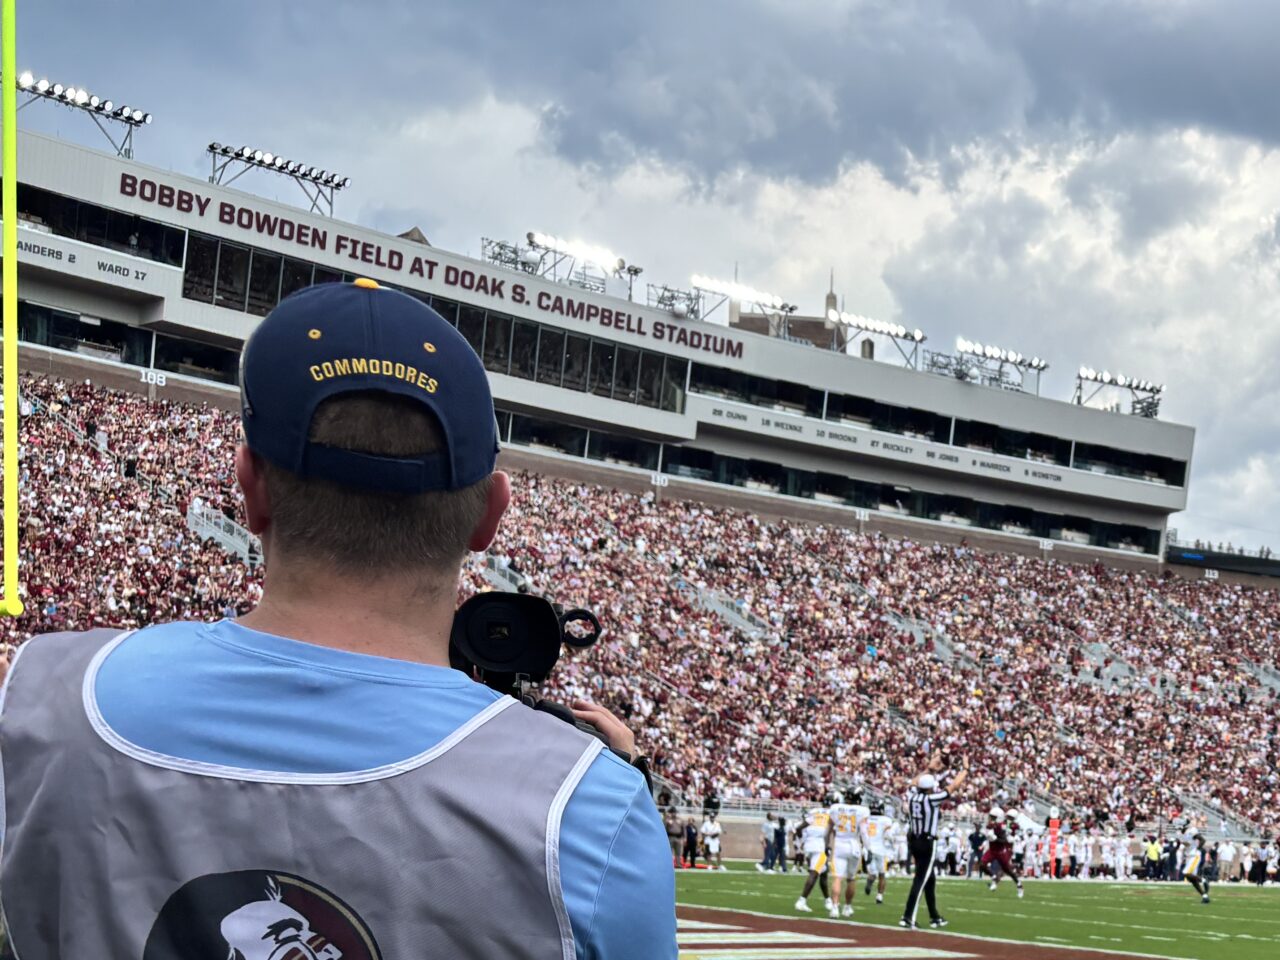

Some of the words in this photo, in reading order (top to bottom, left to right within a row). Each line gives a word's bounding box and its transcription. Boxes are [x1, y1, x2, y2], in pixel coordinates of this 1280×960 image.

[17, 240, 63, 261] ANDERS
[68, 253, 76, 264] 2
[97, 260, 130, 277] WARD
[134, 270, 147, 281] 17
[120, 172, 212, 217] BOBBY
[218, 201, 328, 250] BOWDEN
[335, 234, 404, 271] FIELD
[409, 256, 439, 280] AT
[444, 265, 506, 299] DOAK
[511, 283, 531, 306] S.
[537, 291, 648, 337] CAMPBELL
[652, 321, 744, 359] STADIUM
[139, 370, 166, 386] 108
[309, 358, 439, 394] COMMODORES
